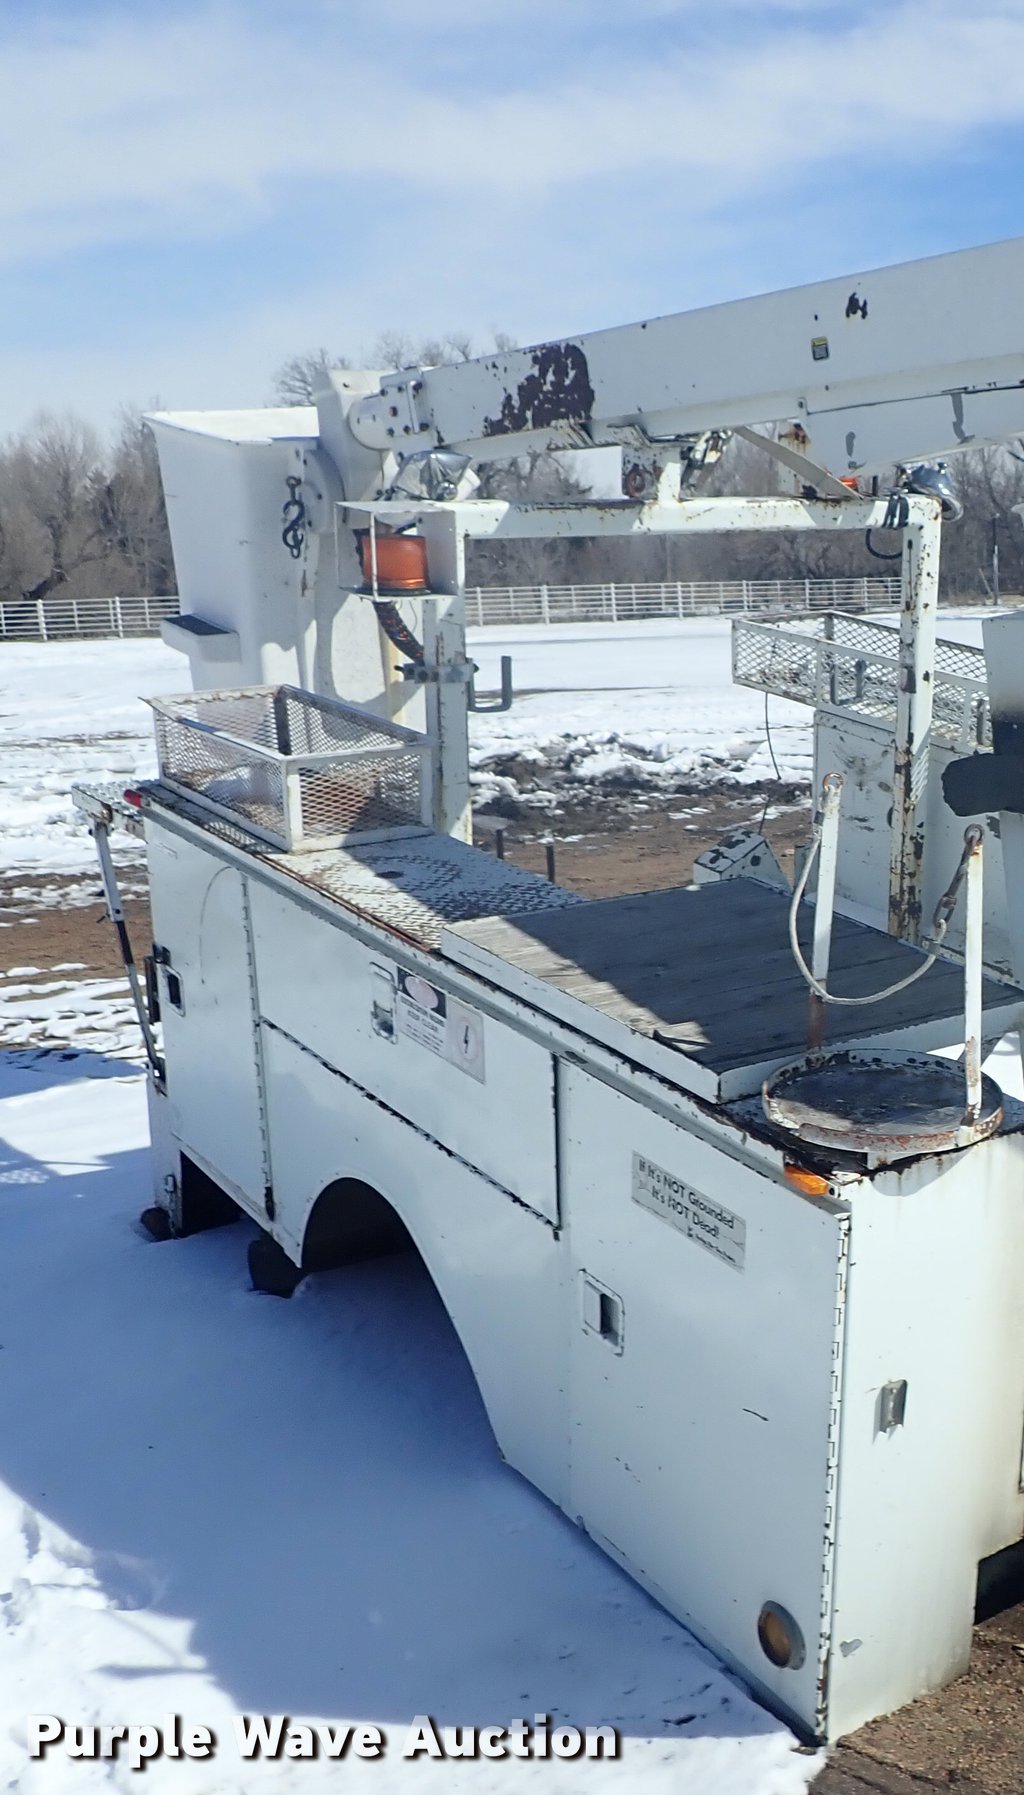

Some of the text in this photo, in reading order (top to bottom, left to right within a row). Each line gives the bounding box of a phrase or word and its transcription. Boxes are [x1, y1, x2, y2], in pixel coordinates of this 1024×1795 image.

[663, 1174, 686, 1198] NOT
[688, 1191, 734, 1229] Grounded
[667, 1195, 690, 1219] NOT
